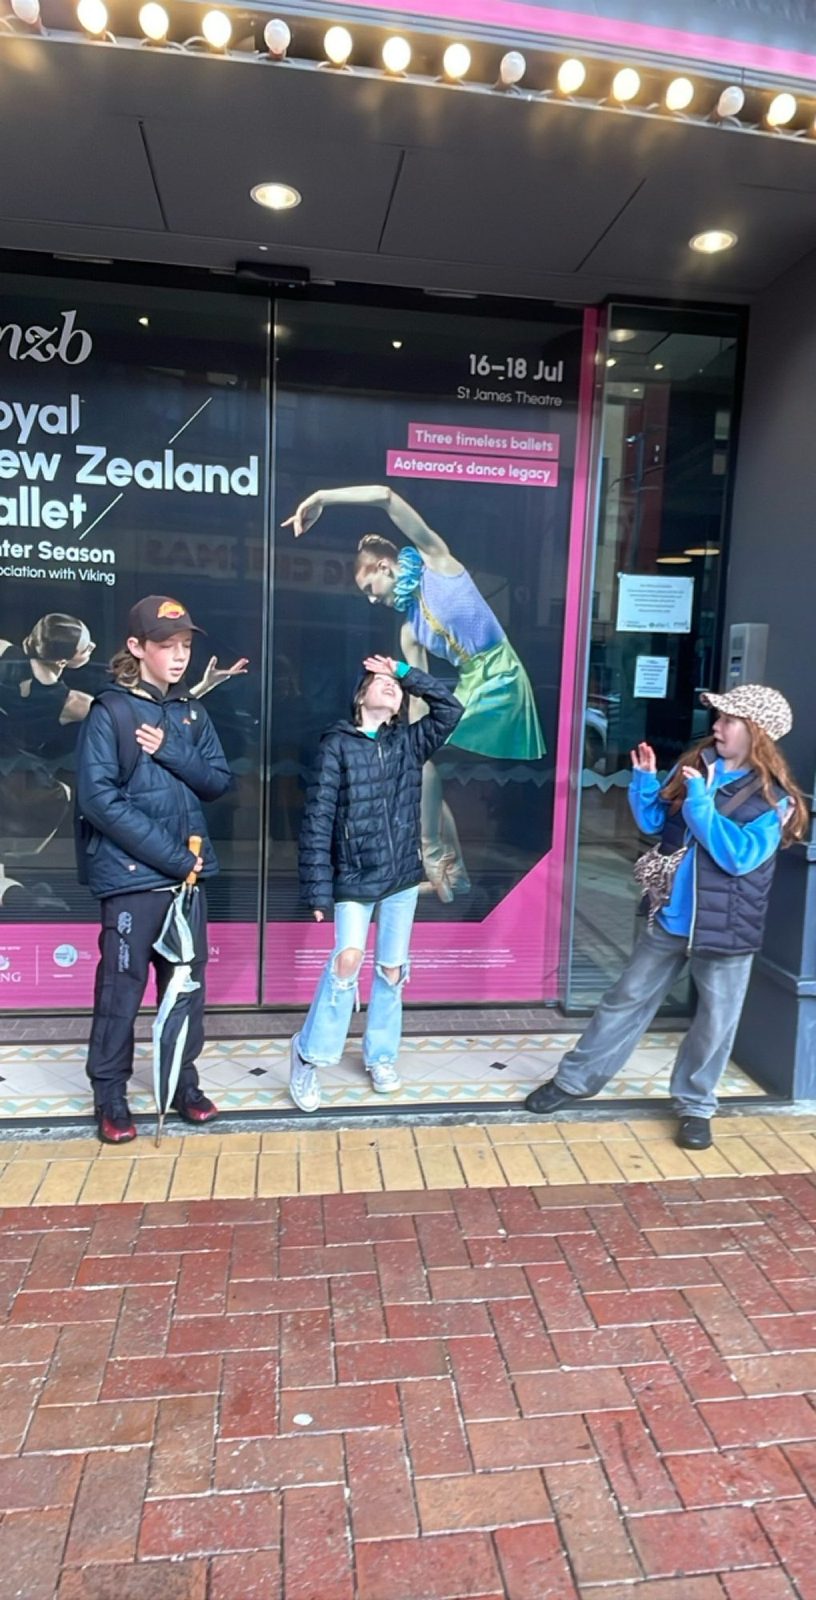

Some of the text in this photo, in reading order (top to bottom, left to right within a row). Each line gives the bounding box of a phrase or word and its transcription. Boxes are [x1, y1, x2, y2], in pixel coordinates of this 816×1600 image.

[533, 360, 564, 382] Jul
[457, 386, 563, 407] St James Theatre
[415, 429, 553, 452] Three timeless ballets
[0, 445, 259, 496] ew Zealand
[394, 457, 551, 483] Aotearoa's dance legacy
[0, 485, 87, 529] allet
[0, 540, 115, 563] ter Season
[48, 567, 76, 580] with
[78, 569, 115, 585] Viking
